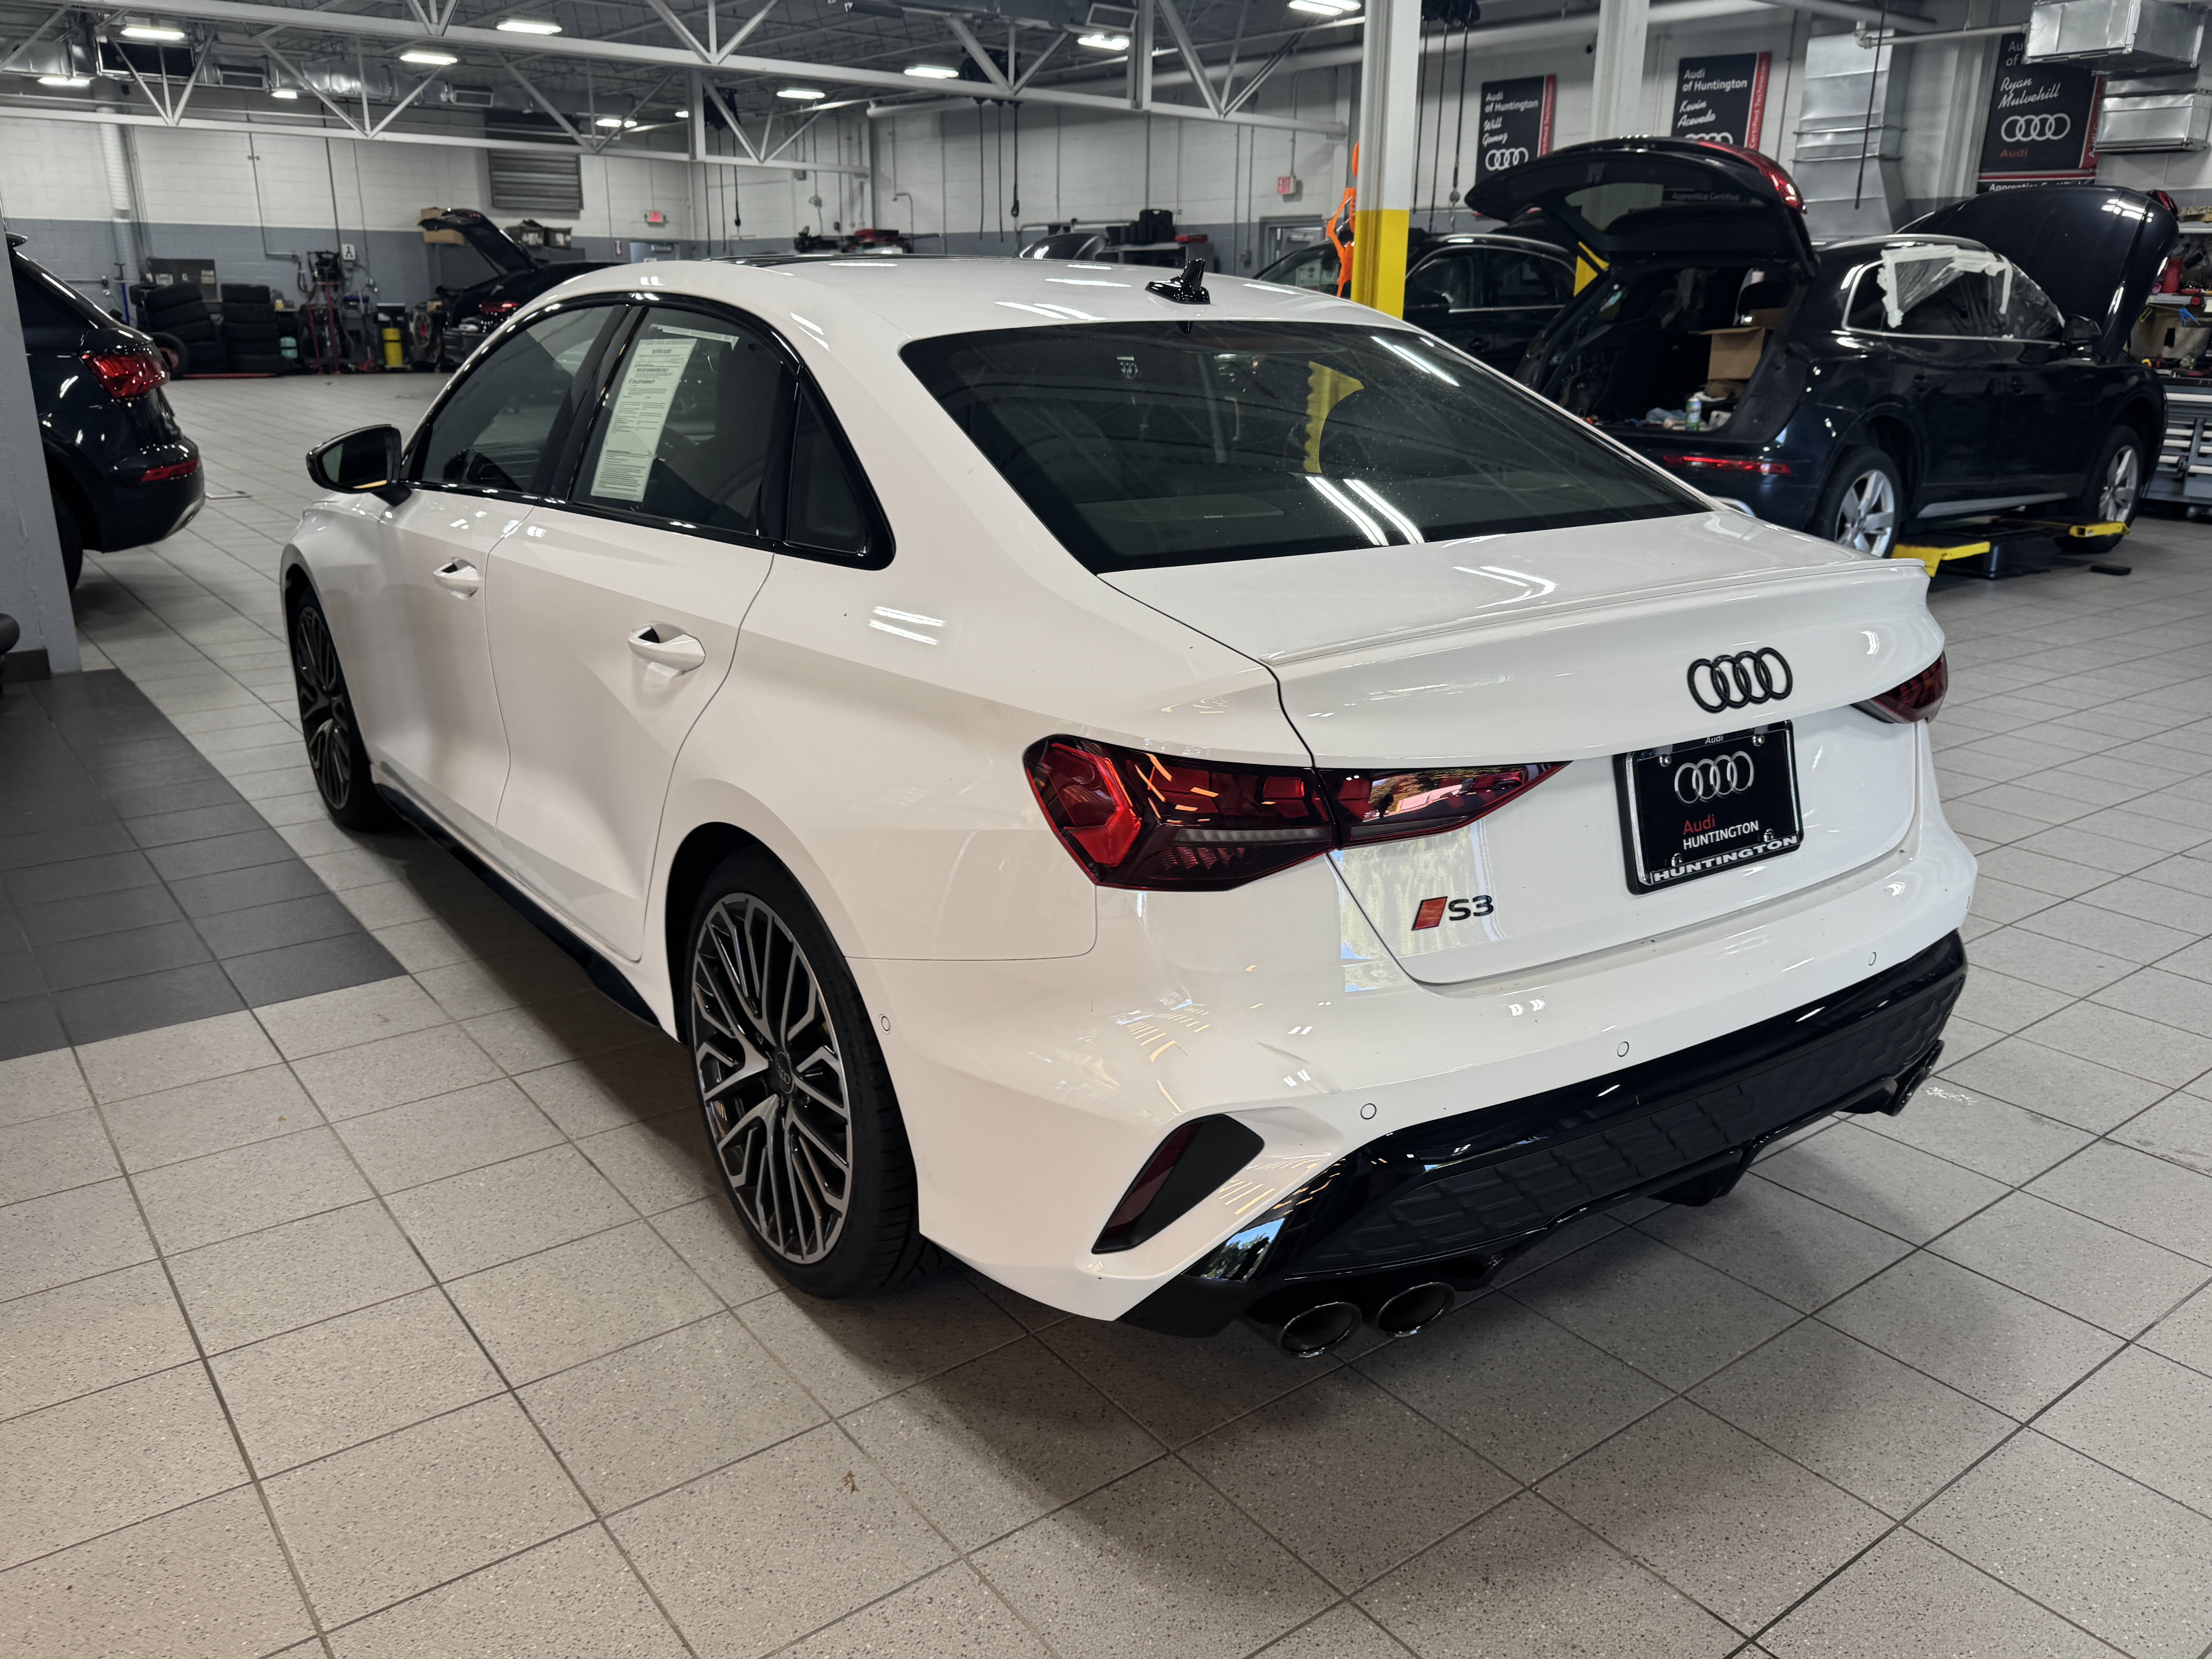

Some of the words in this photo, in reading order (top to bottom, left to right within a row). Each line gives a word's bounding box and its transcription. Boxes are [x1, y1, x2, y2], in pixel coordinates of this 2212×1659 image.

[2008, 41, 2023, 52] Au
[2006, 54, 2019, 66] of
[1684, 68, 1705, 79] Audi
[1682, 81, 1693, 92] of
[1694, 79, 1747, 92] Huntington
[2000, 77, 2032, 94] Ryan
[1486, 91, 1504, 102] Audi
[1997, 82, 2061, 109] Mulvehill
[1484, 102, 1494, 113] of
[1494, 99, 1539, 112] Huntington
[1679, 99, 1707, 113] Kevin
[1999, 148, 2028, 158] Audi
[1705, 735, 1723, 744] Audi
[1683, 814, 1716, 835] Audi
[1683, 820, 1759, 850] HUNTINGTON
[1654, 835, 1798, 882] HUNTINGTON
[1448, 895, 1494, 921] S3
